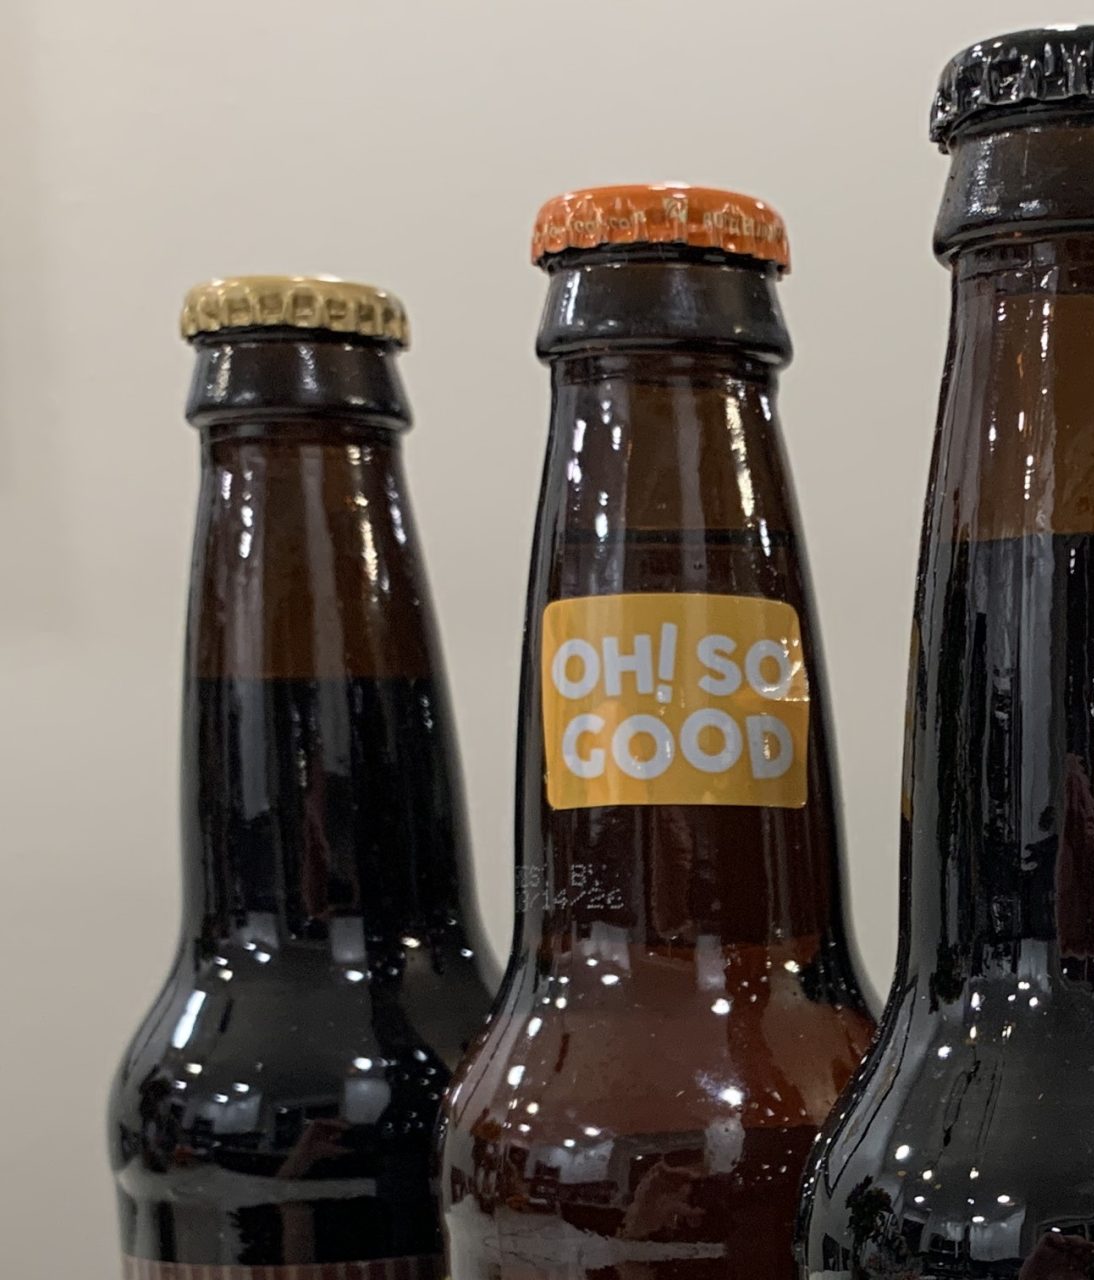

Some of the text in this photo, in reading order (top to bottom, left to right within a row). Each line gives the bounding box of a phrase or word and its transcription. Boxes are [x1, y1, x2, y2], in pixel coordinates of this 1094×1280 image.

[552, 622, 794, 703] OH! SO
[562, 708, 794, 780] GOOD
